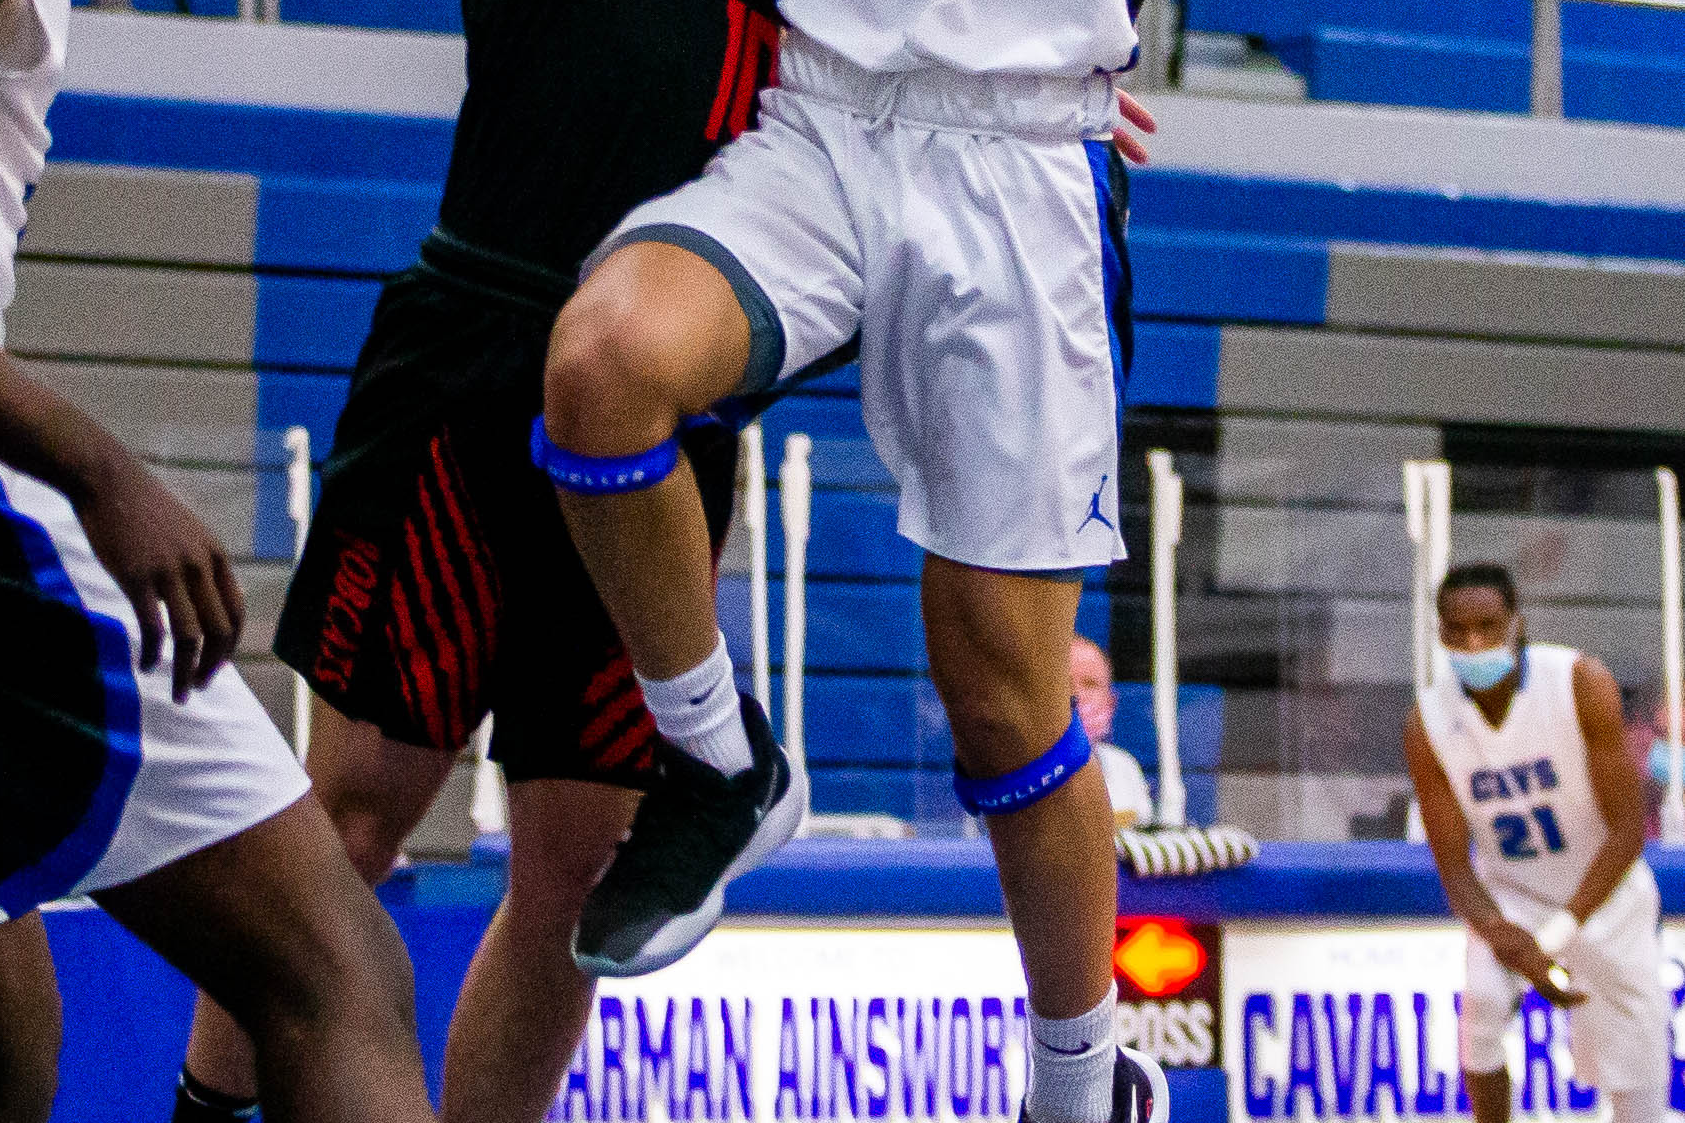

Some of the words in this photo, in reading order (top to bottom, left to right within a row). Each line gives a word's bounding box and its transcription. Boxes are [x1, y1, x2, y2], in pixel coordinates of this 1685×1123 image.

[1492, 806, 1566, 862] 21
[545, 997, 755, 1120] ARMAN
[1243, 993, 1599, 1117] CAVALR
